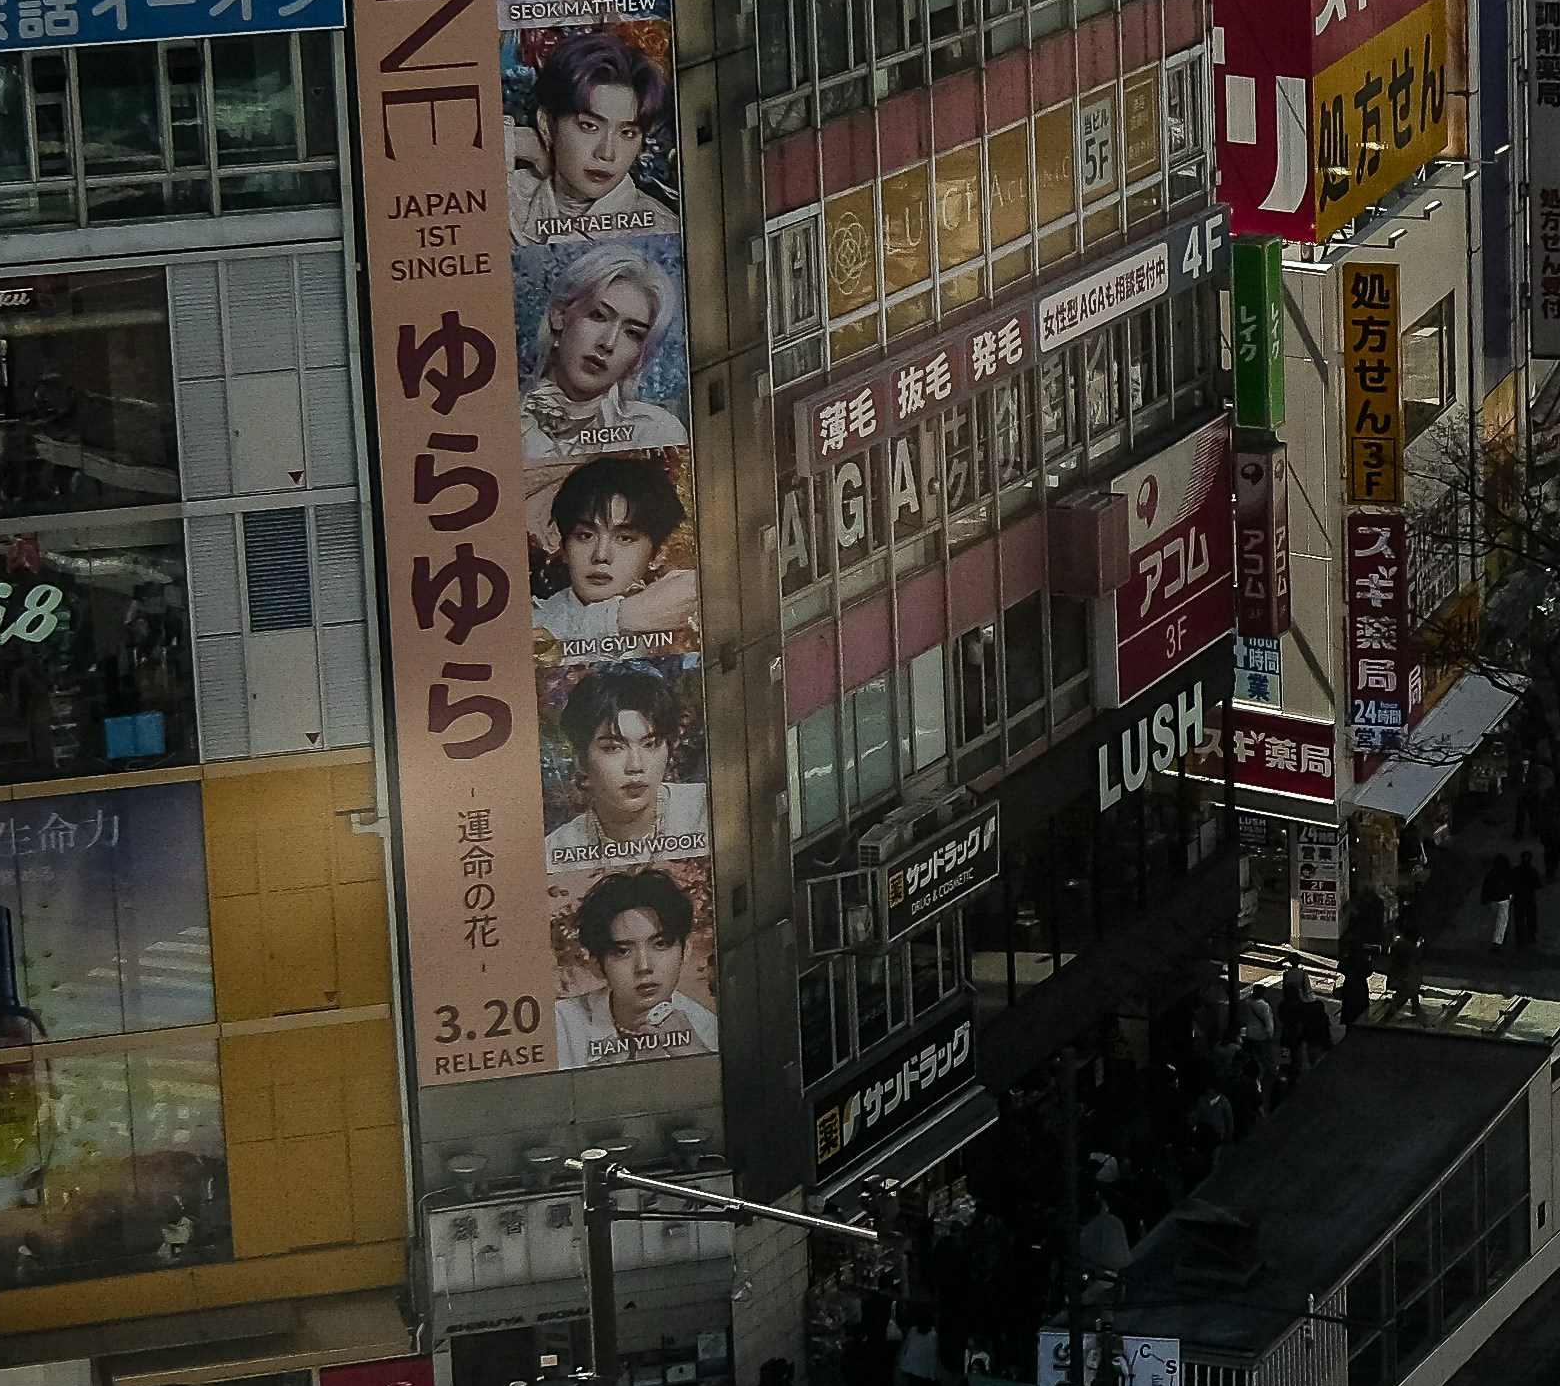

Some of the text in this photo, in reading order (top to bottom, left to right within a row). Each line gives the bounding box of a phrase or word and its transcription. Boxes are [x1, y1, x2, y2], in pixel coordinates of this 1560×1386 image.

[509, 0, 561, 22] SEOK
[1318, 31, 1446, 213] 処方せん
[1084, 135, 1111, 187] 5F
[386, 188, 489, 222] JAPAN
[537, 211, 656, 236] KIM TAE RAE
[416, 224, 462, 250] 1ST
[1181, 216, 1224, 281] 4F
[390, 253, 493, 282] SINGLE
[971, 317, 1025, 381] 発毛
[1239, 304, 1257, 364] レイク
[1350, 271, 1393, 433] 処方せん
[897, 351, 953, 419] 抜毛
[580, 425, 635, 447] RICKY
[819, 388, 878, 457] 薄毛
[1362, 440, 1384, 499] 3F
[395, 308, 516, 762] ゆらゆら
[1138, 527, 1213, 619] アコム
[1242, 527, 1266, 601] アコム
[1354, 525, 1398, 695] スギ薬局
[562, 631, 674, 659] KIM GYU VIN
[1165, 616, 1189, 662] 3F
[1249, 650, 1281, 674] 時間
[1354, 699, 1376, 724] 24
[1097, 681, 1205, 813] LUSH
[552, 833, 706, 864] PARK GUN WOOK
[906, 823, 981, 896] サンドラッグ
[434, 994, 543, 1044] 3.20
[590, 1030, 693, 1059] HAN YU JIN
[434, 1043, 545, 1076] RELEASE
[862, 1020, 972, 1128] サンドラッグ
